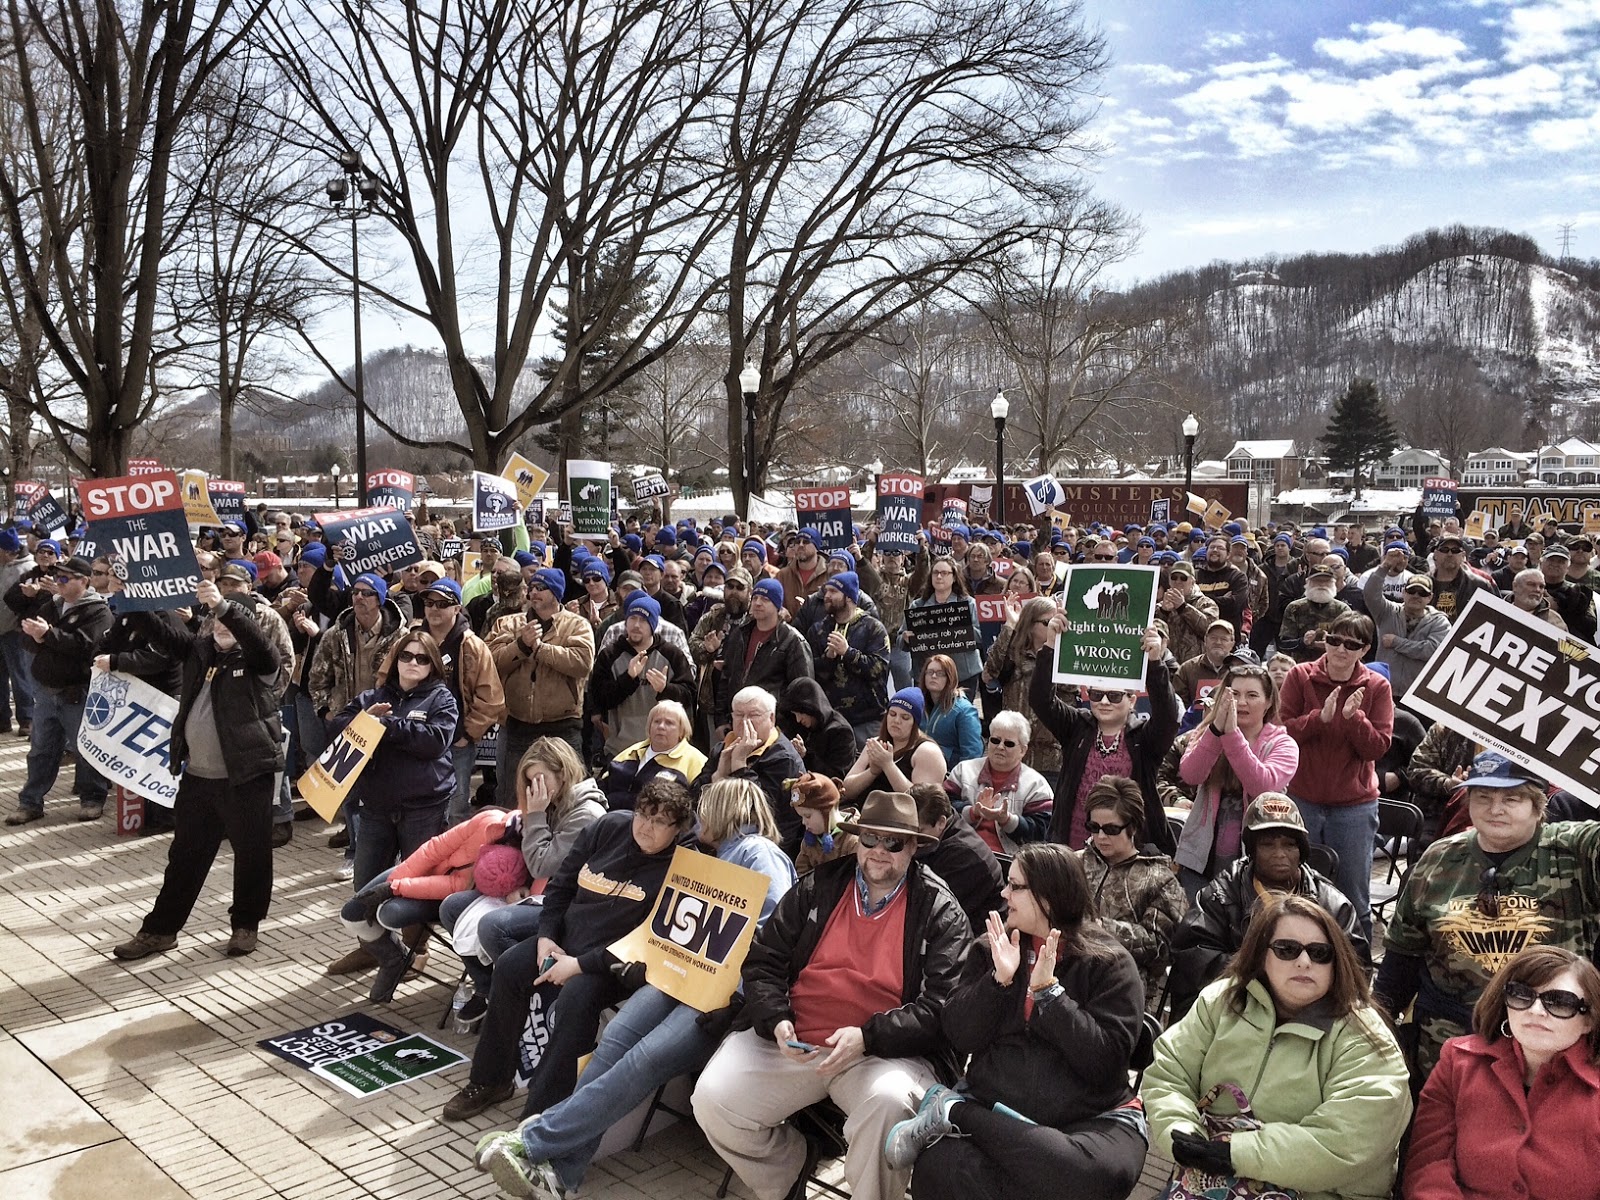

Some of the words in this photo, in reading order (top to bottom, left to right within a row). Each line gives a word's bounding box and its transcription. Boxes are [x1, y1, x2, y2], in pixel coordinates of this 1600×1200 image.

[208, 481, 243, 492] STOP
[367, 472, 411, 489] STOP
[880, 477, 923, 495] STOP
[1426, 479, 1456, 489] STOP
[14, 483, 38, 494] STO
[637, 482, 667, 497] NEXT?
[1036, 478, 1054, 504] aft
[87, 480, 174, 516] STOP
[214, 498, 239, 508] WAR
[373, 495, 406, 511] WAR
[797, 490, 847, 509] STOP
[943, 499, 967, 509] STOP
[1429, 493, 1452, 503] WAR
[31, 502, 56, 521] WAR
[884, 506, 917, 523] WAR
[1069, 503, 1150, 513] COUNCIL
[1423, 506, 1453, 514] WORKERS
[218, 513, 243, 521] ORKERS
[577, 518, 606, 526] WRONG
[815, 512, 827, 520] THE
[126, 518, 148, 532] THE
[341, 517, 398, 546] WAR
[893, 522, 903, 531] ON
[878, 531, 919, 545] WORKERS
[74, 540, 97, 558] AR
[112, 532, 180, 564] WAR
[368, 540, 382, 552] ON
[345, 541, 416, 576] WORKERS
[141, 564, 158, 578] ON
[991, 560, 1011, 573] OP
[123, 575, 199, 599] WORKERS
[908, 610, 928, 619] Some
[944, 605, 955, 614] rob
[957, 606, 969, 614] you
[912, 618, 928, 627] with
[937, 615, 947, 624] six
[1066, 620, 1095, 634] Right
[1098, 623, 1110, 634] to
[1113, 623, 1145, 636] Work
[916, 630, 939, 640] others
[941, 629, 952, 638] rob
[953, 628, 967, 639] you
[911, 643, 928, 653] with
[936, 640, 965, 650] fountain
[1073, 644, 1132, 660] WRONG
[233, 669, 244, 678] CAT
[1072, 660, 1129, 675] #wvwkrs
[1462, 620, 1556, 682] ARE
[1563, 664, 1600, 712] YO
[78, 725, 138, 779] Teamsters
[1472, 730, 1530, 765] www.umwa.org
[138, 772, 177, 799] Loca
[671, 873, 691, 888] UNITED
[690, 880, 748, 909] STEELWORKERS
[1449, 900, 1470, 911] WE
[1507, 896, 1539, 910] ONE
[650, 885, 750, 966] USW
[1456, 929, 1530, 955] UMWA
[648, 937, 662, 948] UNITY
[660, 943, 670, 953] AND
[685, 954, 693, 963] FOR
[692, 959, 717, 975] WORKERS
[529, 992, 550, 1056] UTS
